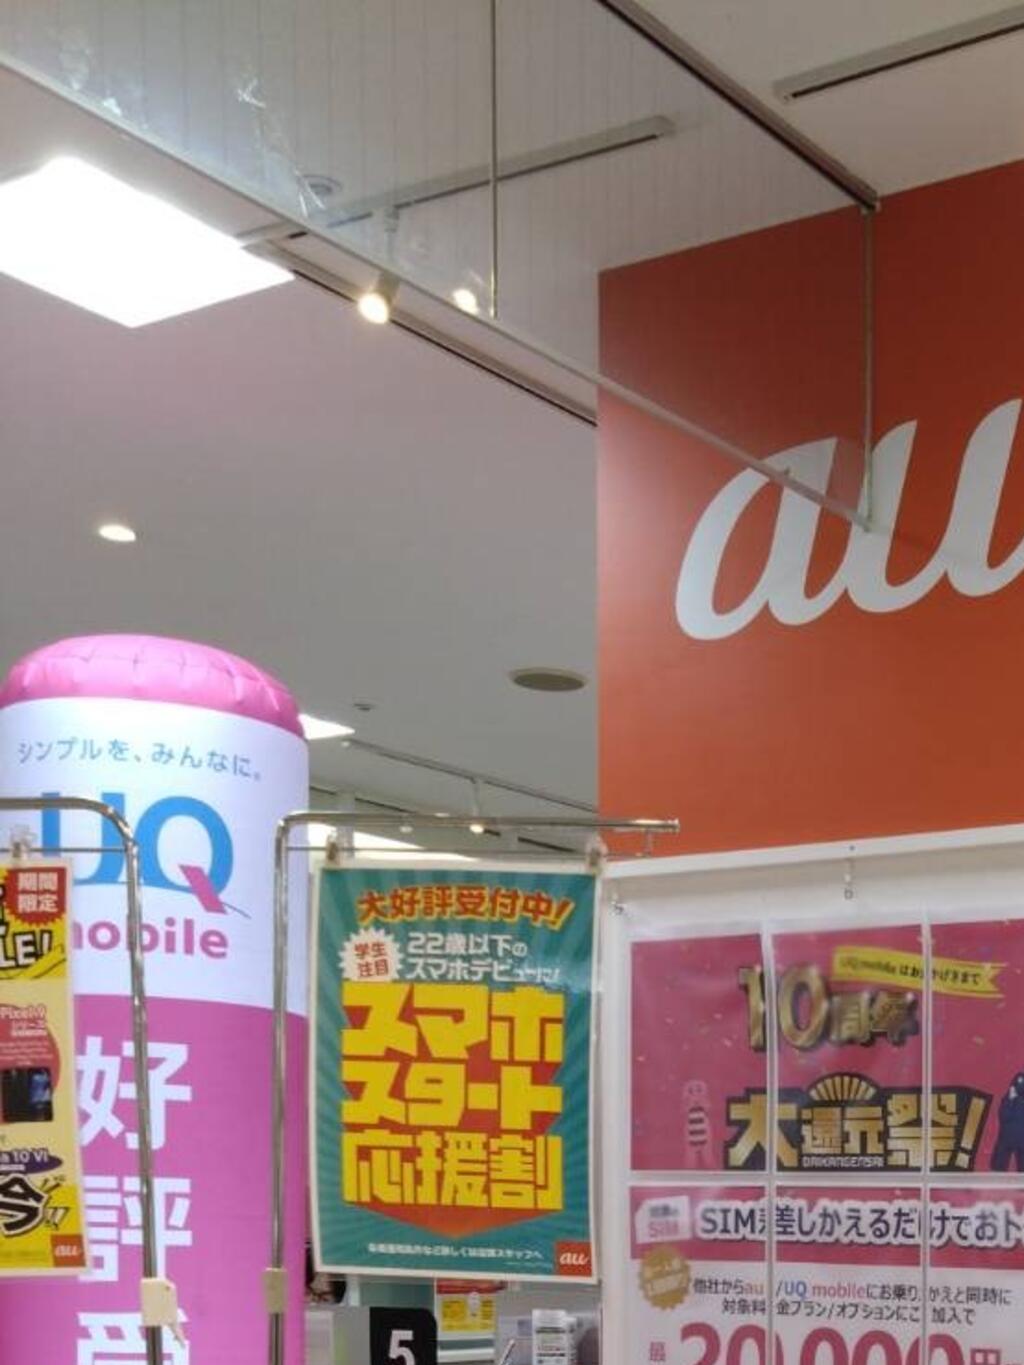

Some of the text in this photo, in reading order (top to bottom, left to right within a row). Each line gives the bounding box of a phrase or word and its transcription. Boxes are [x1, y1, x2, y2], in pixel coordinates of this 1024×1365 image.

[18, 738, 262, 781] シンプルを、みんなに。
[41, 792, 234, 915] UQ
[18, 894, 58, 913] 限定
[406, 932, 528, 957] 22歳以下の
[357, 959, 390, 979] 注目
[342, 981, 564, 1063] スマホ
[342, 1059, 564, 1131] スタート
[342, 1128, 564, 1210] 応援割
[559, 1253, 589, 1265] au
